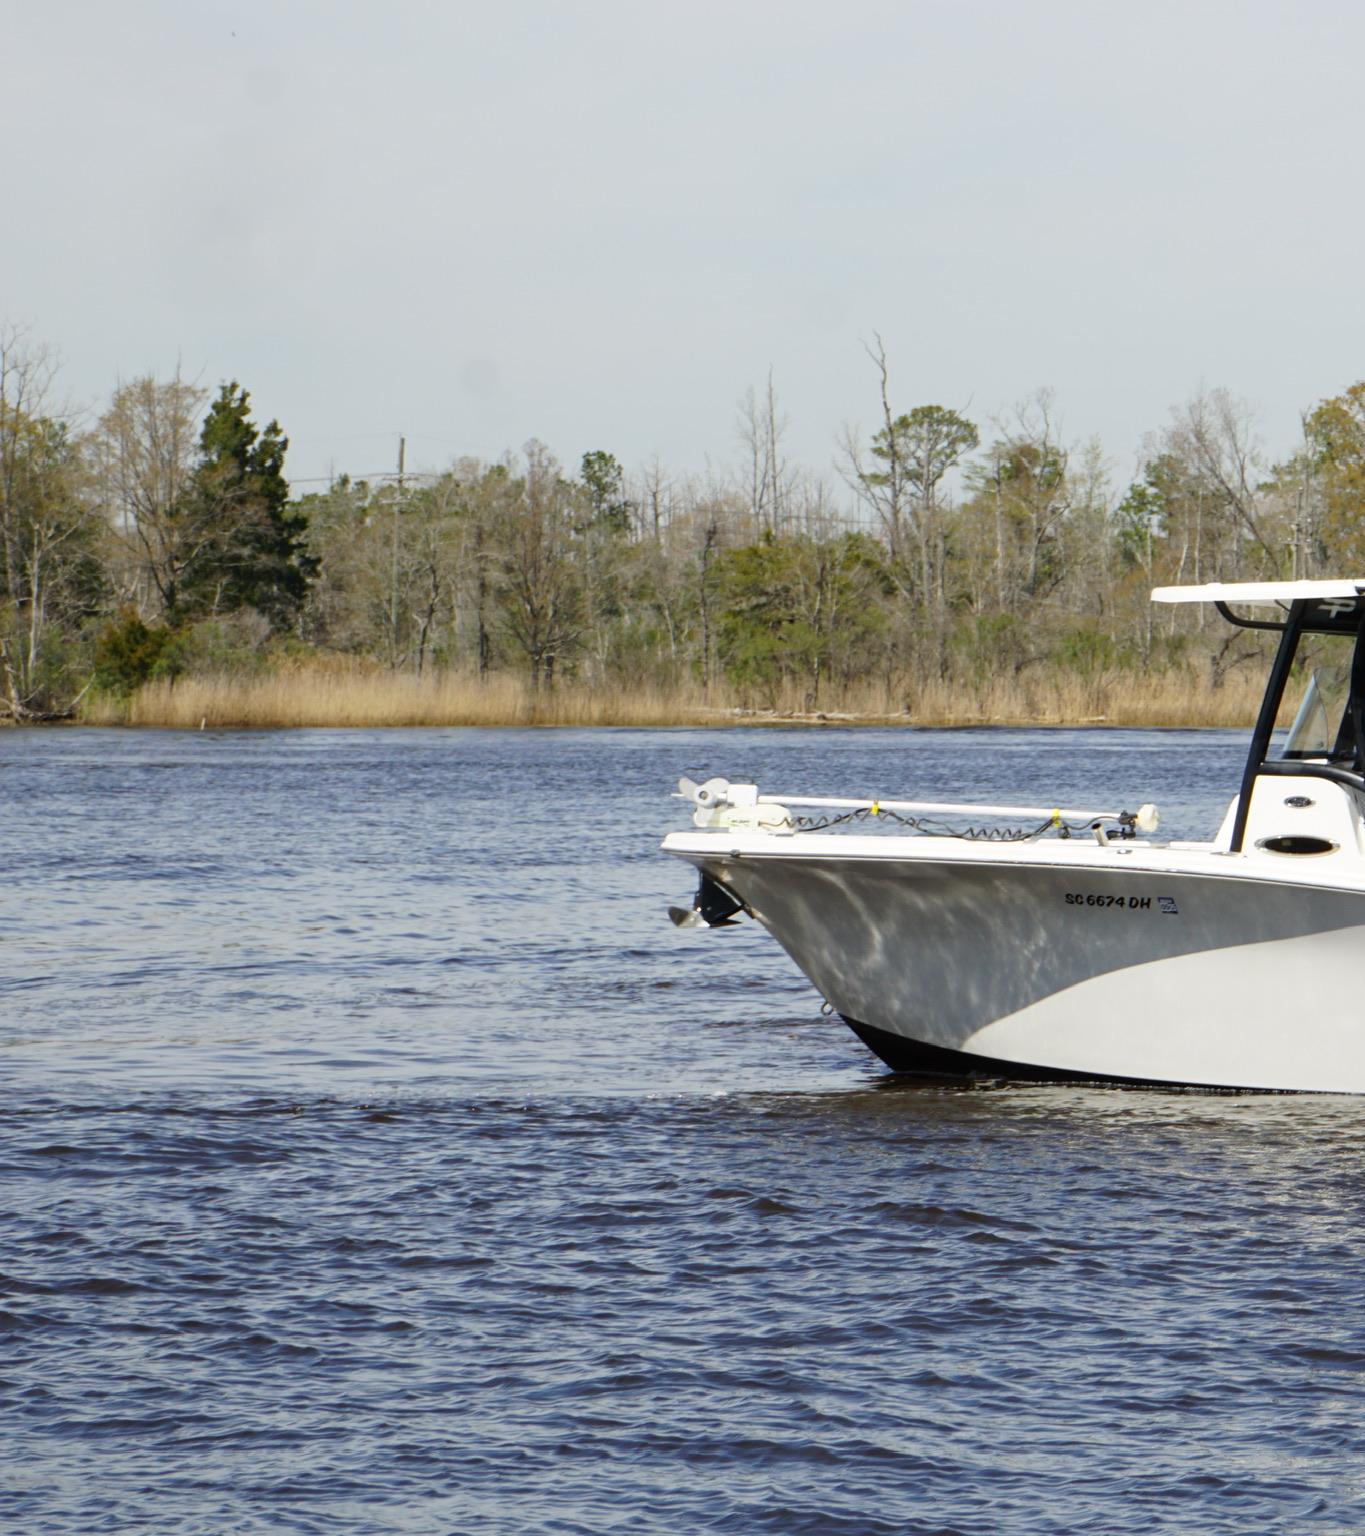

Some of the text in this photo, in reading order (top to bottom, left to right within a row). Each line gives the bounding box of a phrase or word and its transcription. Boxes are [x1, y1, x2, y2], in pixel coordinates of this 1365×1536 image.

[1065, 893, 1083, 905] SC
[1087, 895, 1125, 908] 6674
[1129, 897, 1151, 909] DH
